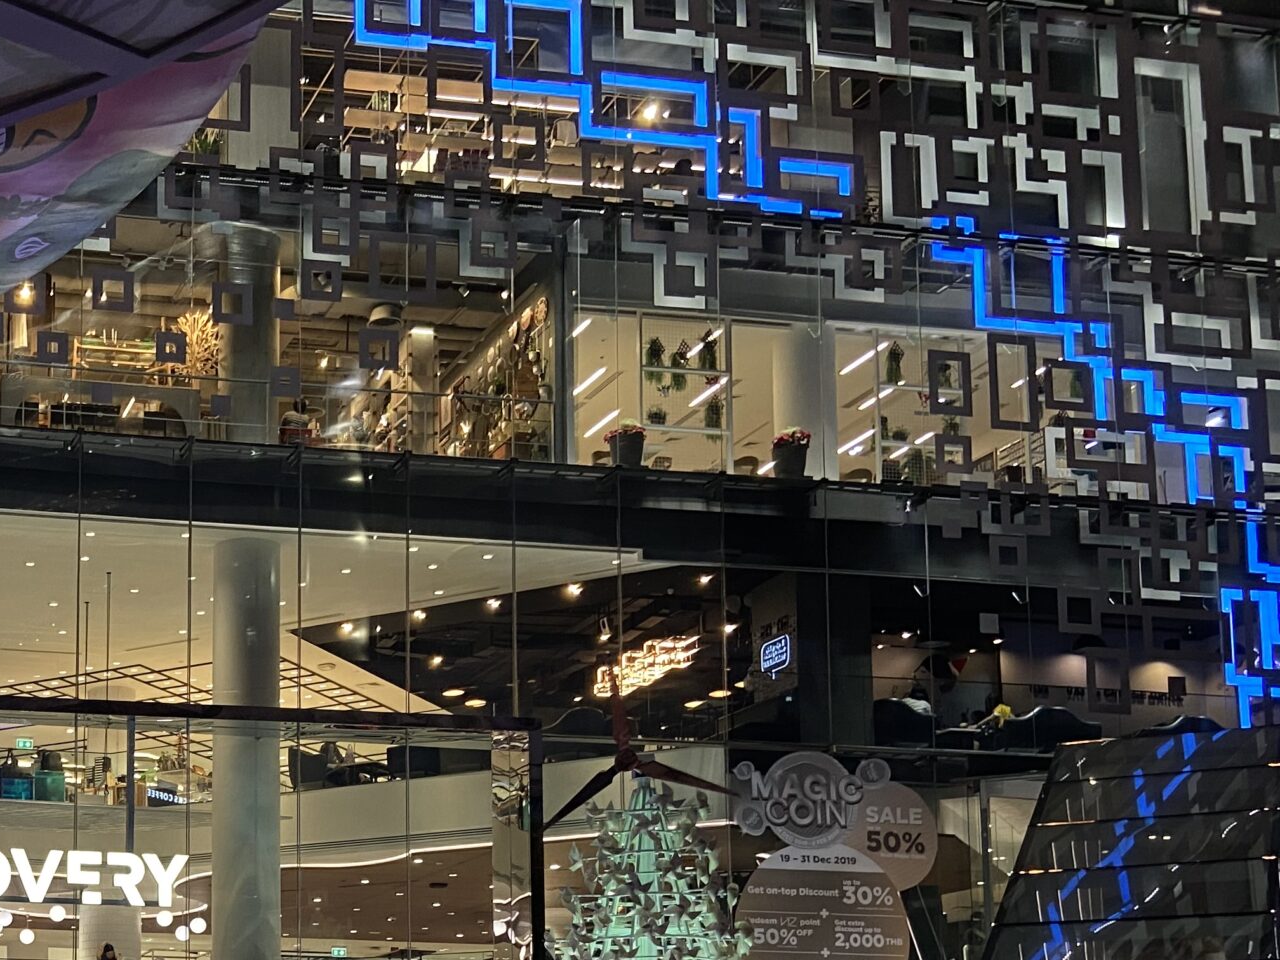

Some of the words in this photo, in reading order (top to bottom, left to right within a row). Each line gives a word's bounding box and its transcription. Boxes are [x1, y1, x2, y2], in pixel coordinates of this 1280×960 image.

[750, 769, 864, 807] MAGIC
[764, 798, 849, 828] COIN
[865, 806, 923, 825] SALE
[866, 830, 926, 855] 50%
[780, 853, 790, 863] 19
[800, 855, 810, 864] 31
[813, 855, 831, 864] Dec
[834, 855, 857, 866] 2019
[747, 885, 764, 895] Get
[766, 886, 798, 899] on-top
[799, 887, 839, 898] Discount
[842, 886, 893, 907] 30%
[745, 917, 778, 926] edeem
[800, 918, 821, 928] point
[753, 928, 798, 946] 50%
[796, 928, 814, 937] OFF
[834, 934, 885, 950] 2,000
